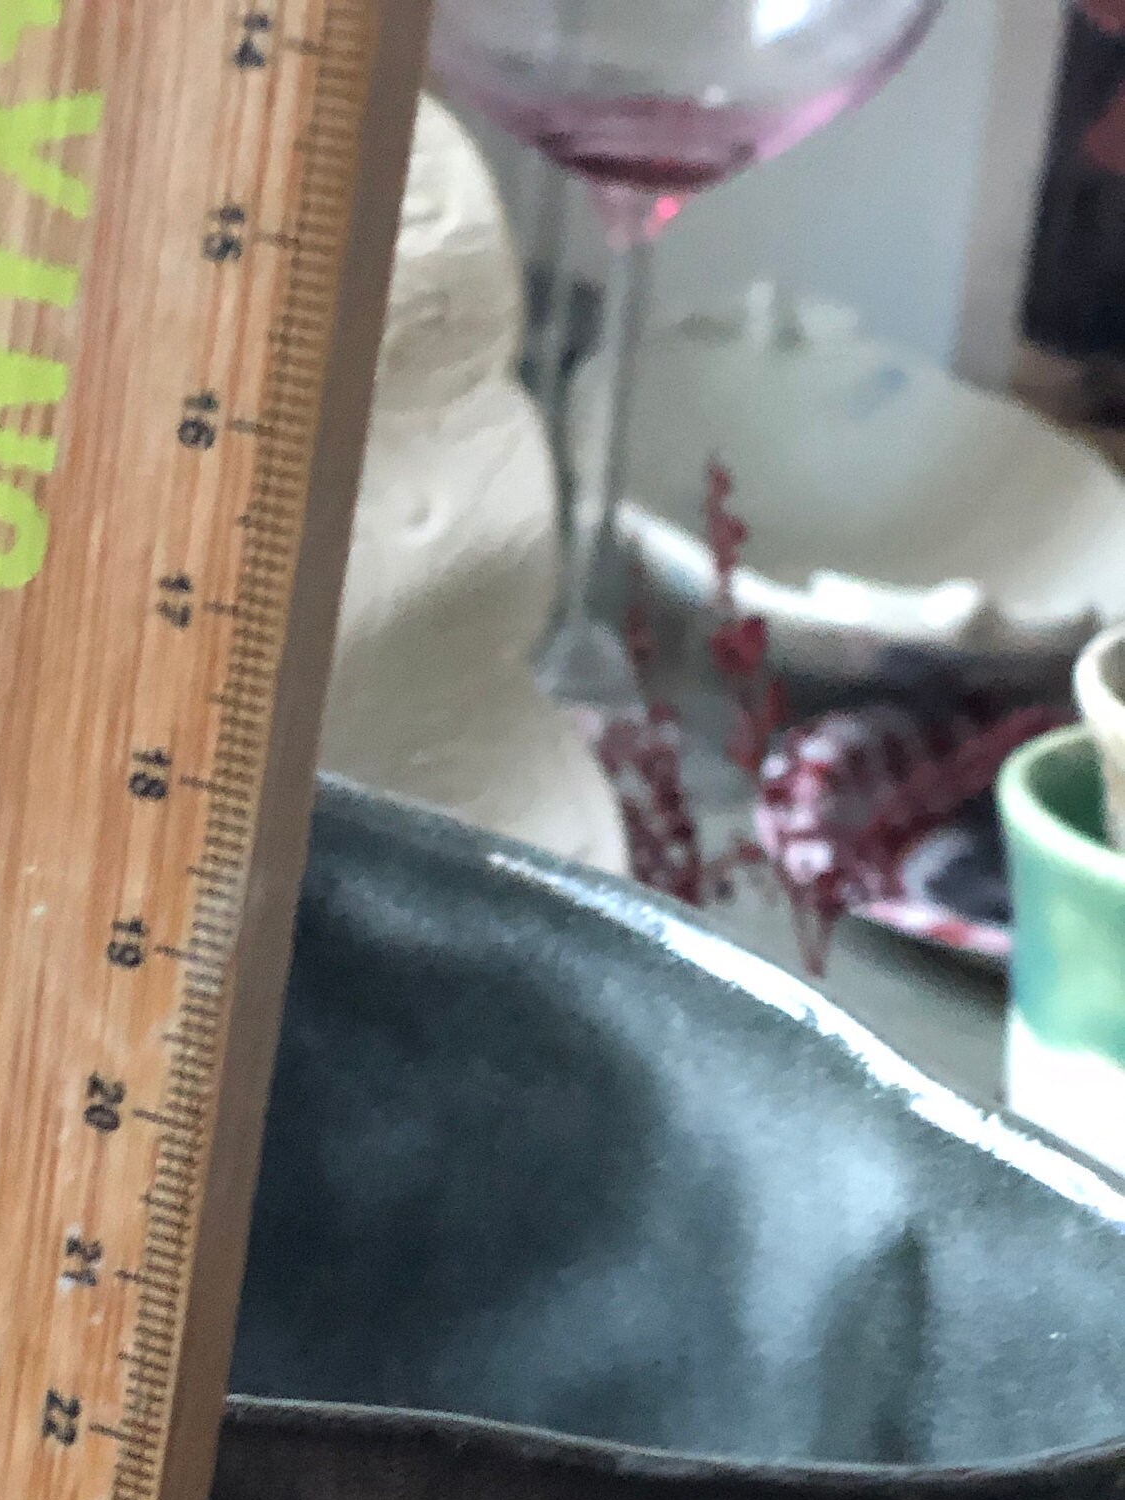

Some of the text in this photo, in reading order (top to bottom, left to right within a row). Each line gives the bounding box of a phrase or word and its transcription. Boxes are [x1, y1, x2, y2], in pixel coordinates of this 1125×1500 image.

[232, 13, 271, 70] 14
[202, 203, 247, 263] 15
[177, 390, 219, 450] 16
[157, 574, 193, 628] 17
[128, 748, 173, 801] 18
[107, 918, 149, 969] 19
[83, 1072, 125, 1134] 20
[63, 1236, 103, 1288] 21
[41, 1388, 81, 1446] 22
